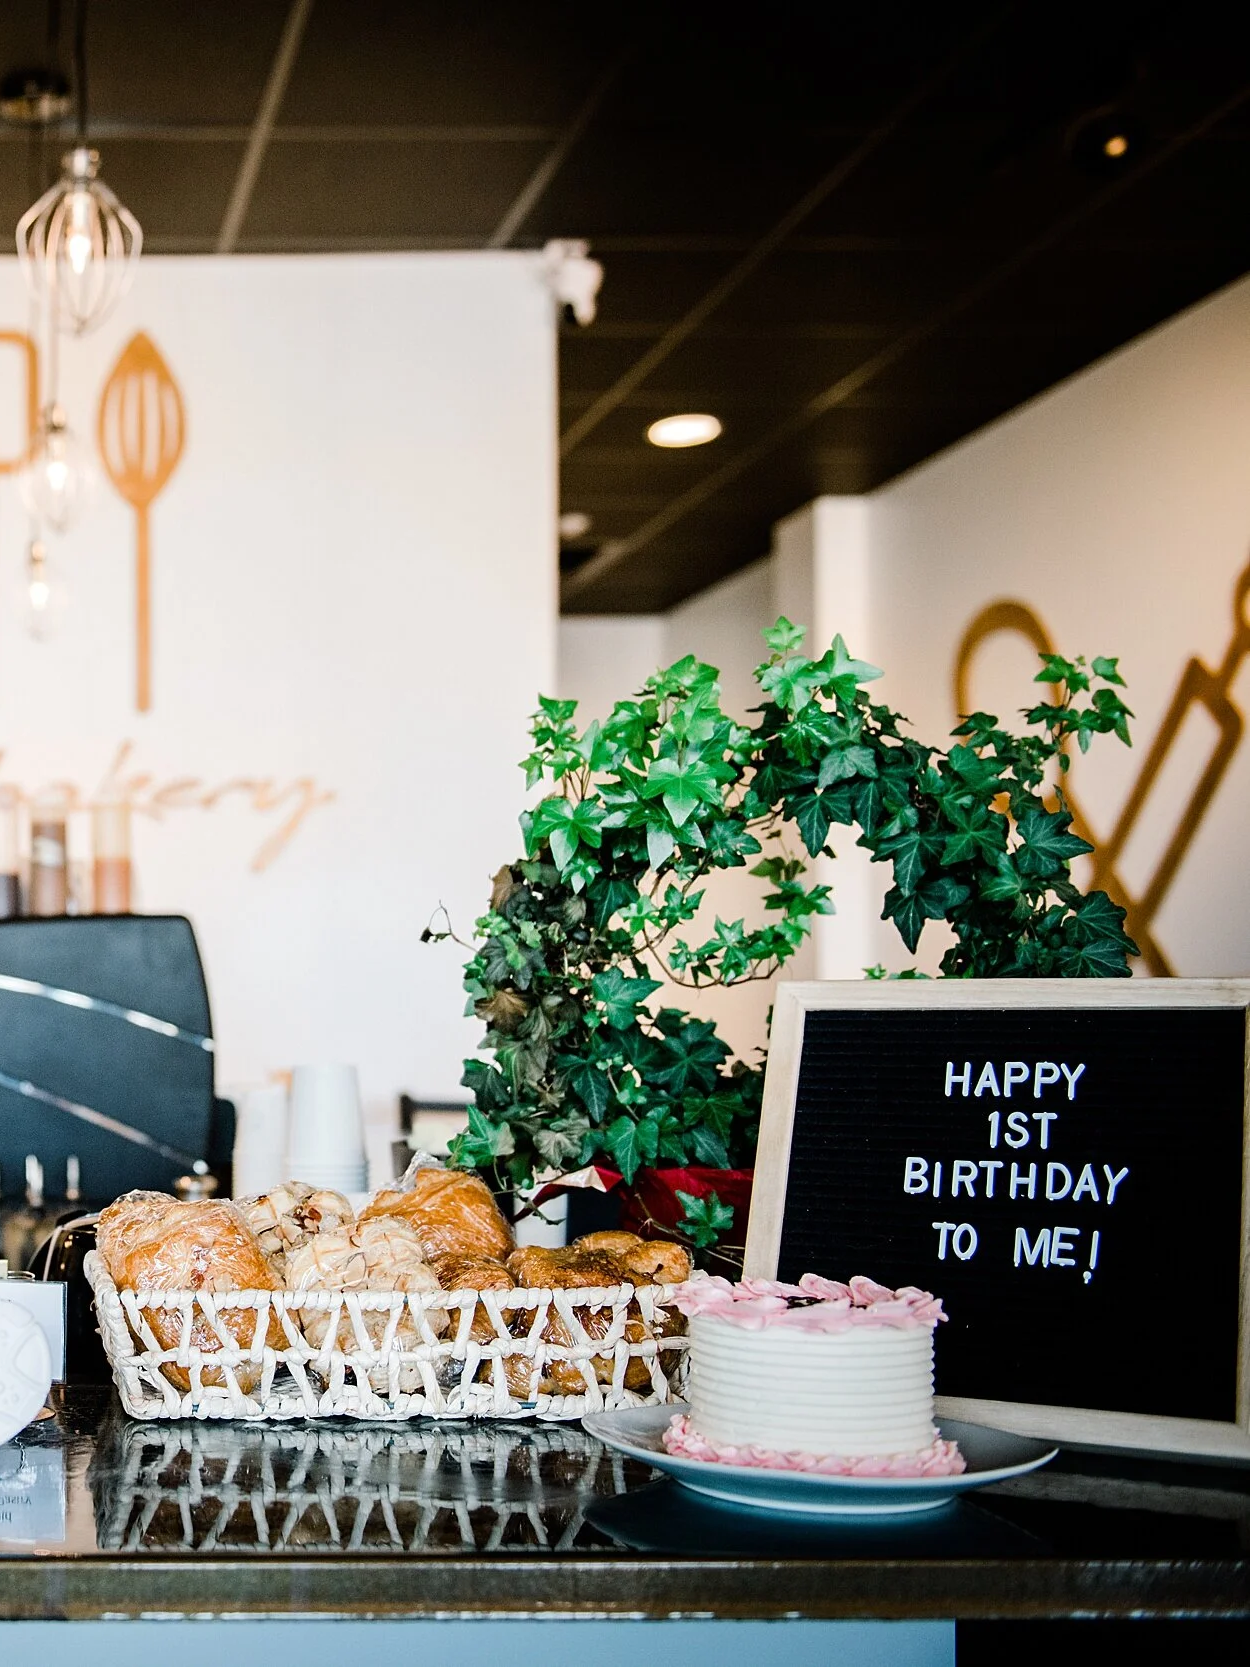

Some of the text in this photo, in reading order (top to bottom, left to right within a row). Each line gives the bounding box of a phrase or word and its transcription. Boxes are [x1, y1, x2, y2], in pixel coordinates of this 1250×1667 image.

[944, 1061, 1085, 1100] HAPPY
[988, 1111, 1057, 1149] 1ST
[903, 1156, 1129, 1205] BIRTHDAY
[932, 1222, 1100, 1284] TO ME!
